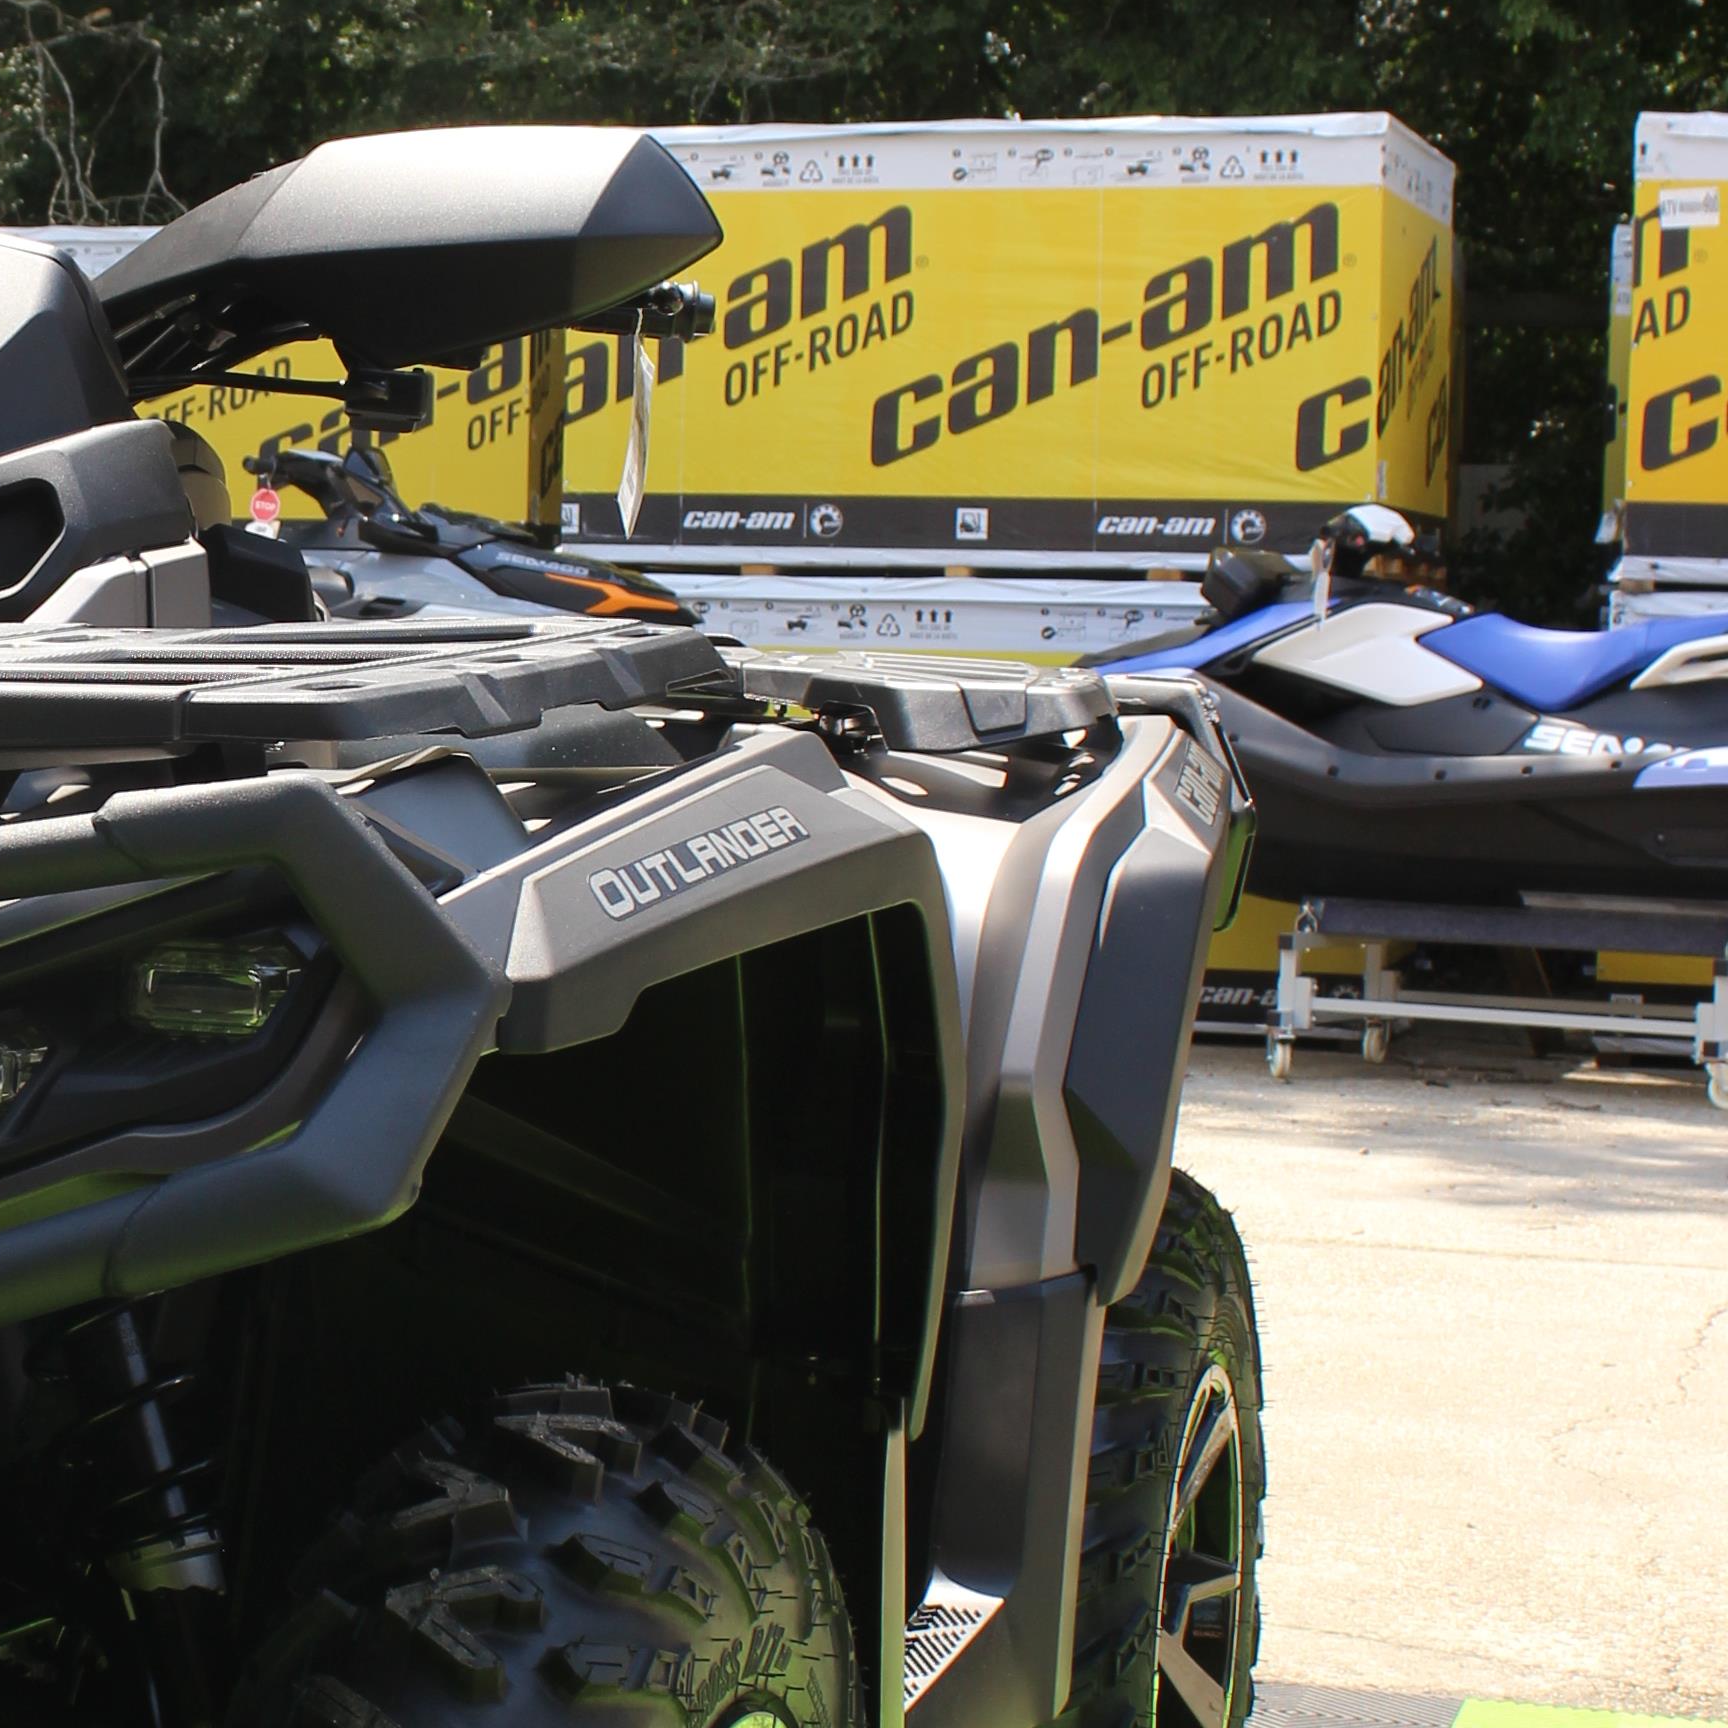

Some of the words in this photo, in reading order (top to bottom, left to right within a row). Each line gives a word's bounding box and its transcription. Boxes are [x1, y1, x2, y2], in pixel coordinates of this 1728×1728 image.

[725, 289, 914, 407] OFF-ROAD
[872, 201, 1340, 468] can-am
[1141, 289, 1342, 410] OFF-ROAD
[682, 510, 796, 531] can-am
[1096, 515, 1217, 536] can-am
[588, 805, 810, 921] OUTLANDER
